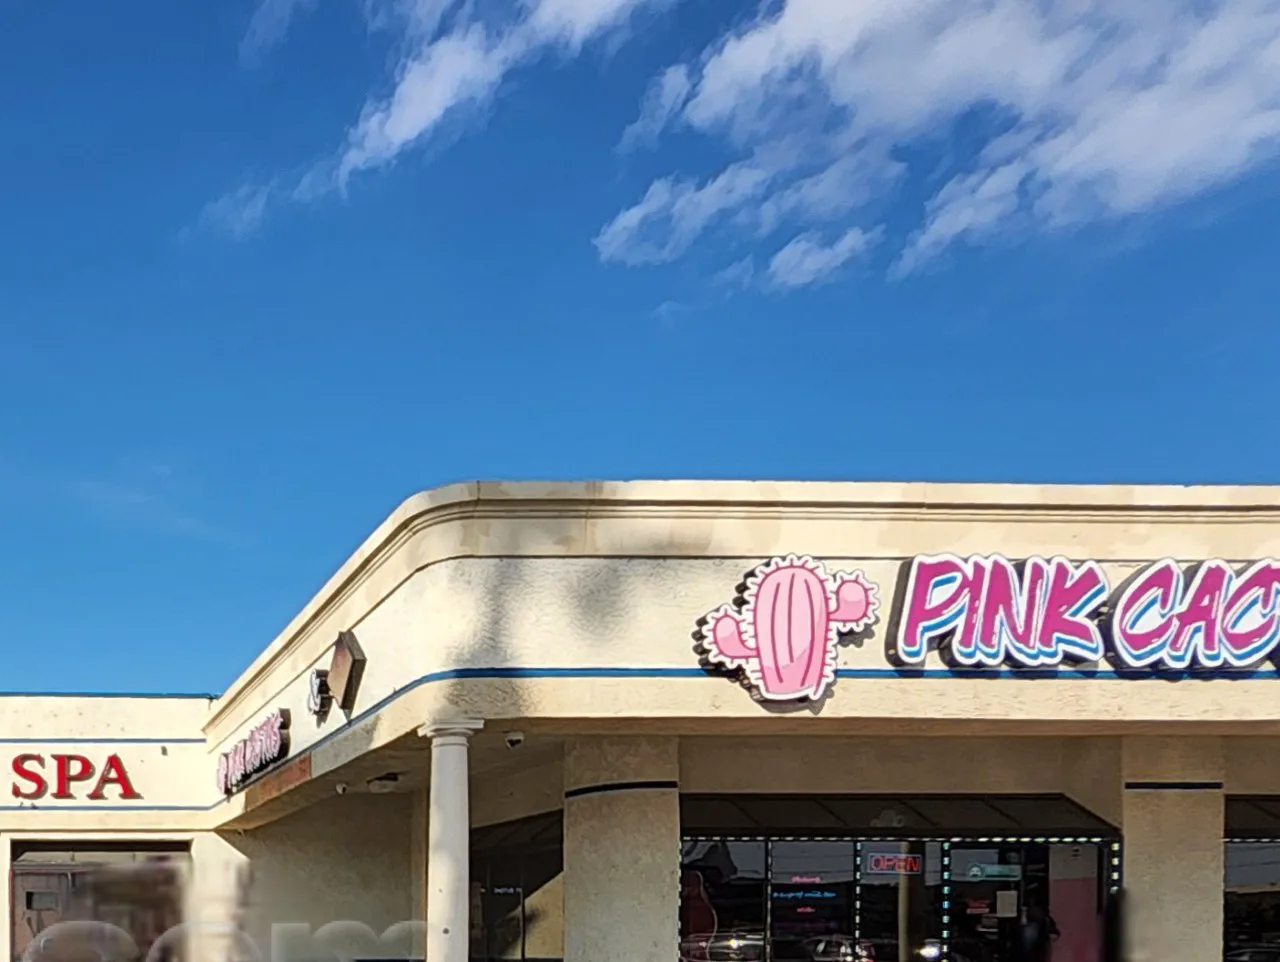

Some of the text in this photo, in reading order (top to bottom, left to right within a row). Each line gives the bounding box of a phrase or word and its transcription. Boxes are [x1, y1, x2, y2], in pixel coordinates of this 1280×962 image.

[895, 554, 1110, 666] PINK
[12, 752, 144, 800] SPA
[871, 855, 920, 872] OPEN
